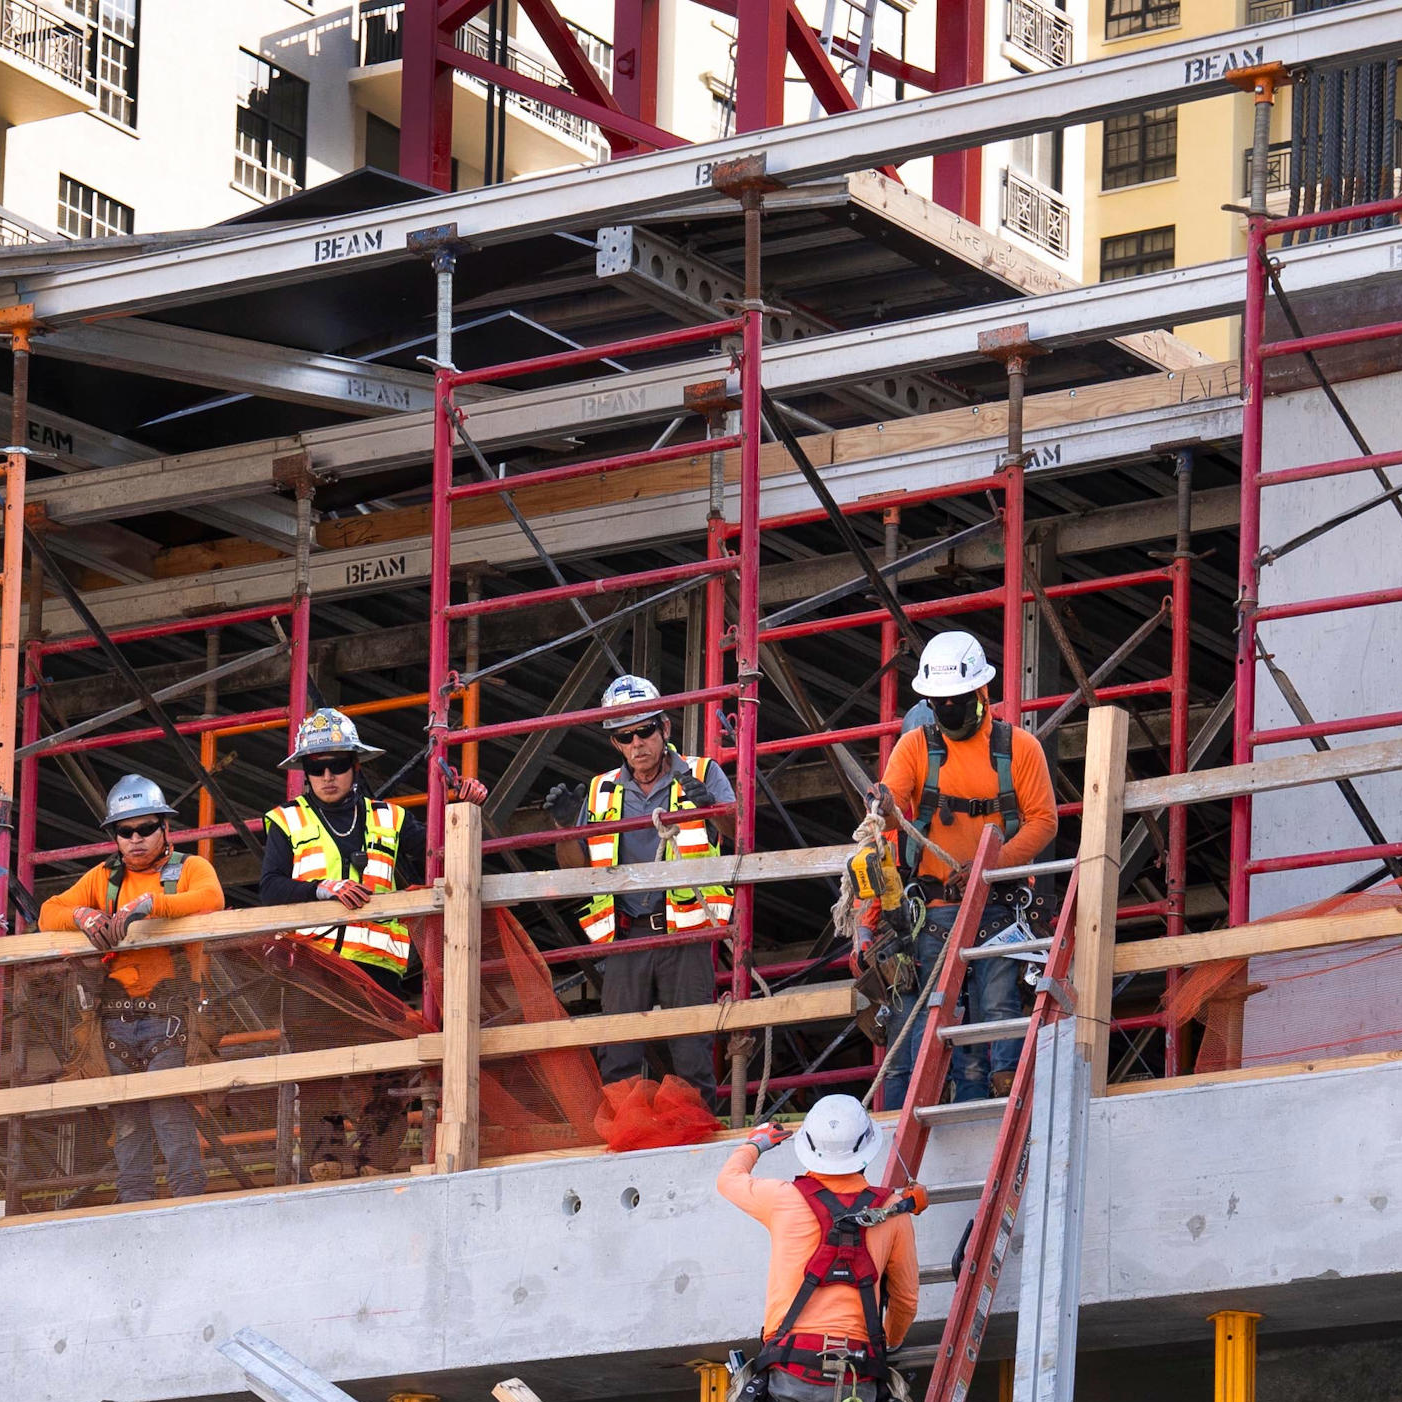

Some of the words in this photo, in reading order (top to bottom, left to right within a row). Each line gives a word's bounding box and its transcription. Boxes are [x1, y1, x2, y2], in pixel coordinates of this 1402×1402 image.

[1185, 46, 1261, 85] BEAM
[314, 229, 383, 262] BEAM
[949, 224, 982, 252] LAKE
[986, 243, 1018, 269] VIEW
[348, 378, 410, 409] BEAM
[580, 387, 646, 421] BEAM
[27, 420, 74, 454] EAM
[346, 556, 405, 584] BEAM
